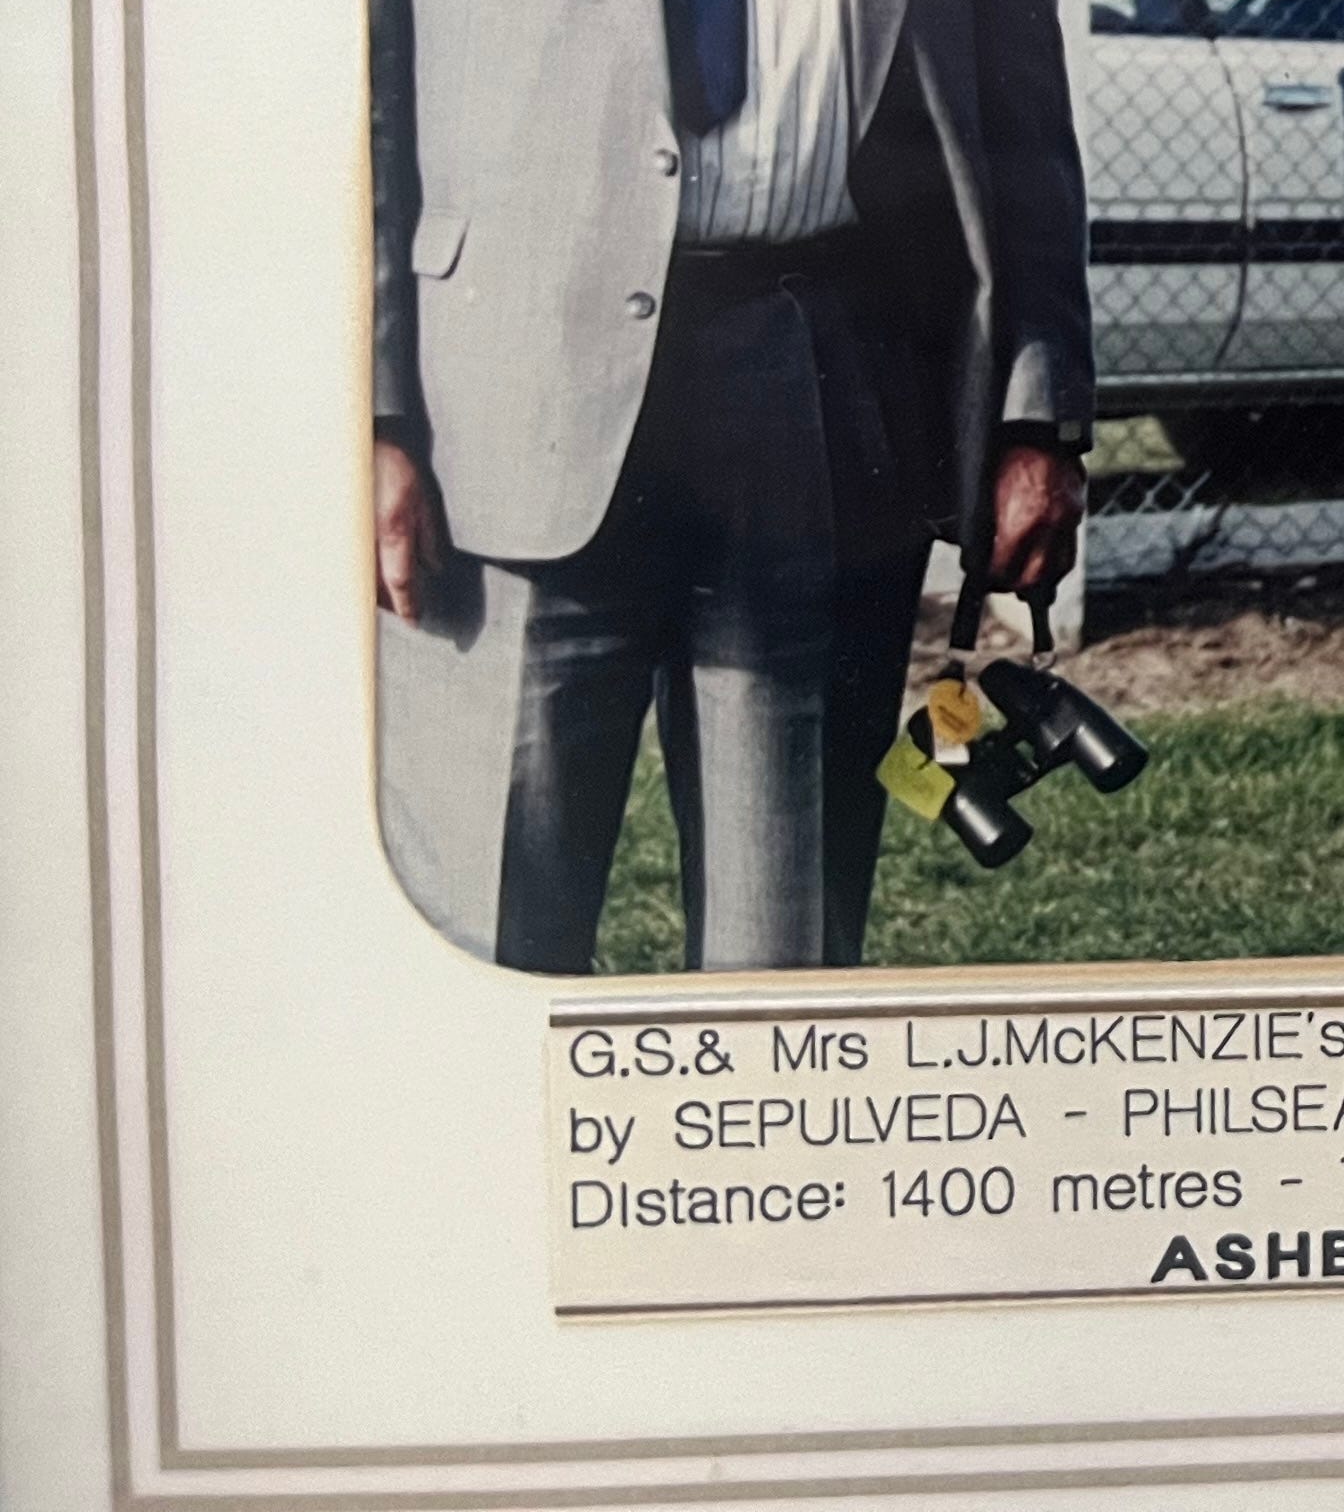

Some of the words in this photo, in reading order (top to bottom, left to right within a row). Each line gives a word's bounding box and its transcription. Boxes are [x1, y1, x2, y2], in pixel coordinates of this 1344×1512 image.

[773, 1024, 869, 1073] Mrs
[569, 1107, 635, 1166] by
[674, 1093, 1027, 1150] SEPULVEDA
[1064, 1110, 1087, 1118] -
[571, 1178, 845, 1230] Distance:
[882, 1166, 1015, 1218] 1400
[1052, 1163, 1243, 1213] metres
[1280, 1178, 1303, 1187] -
